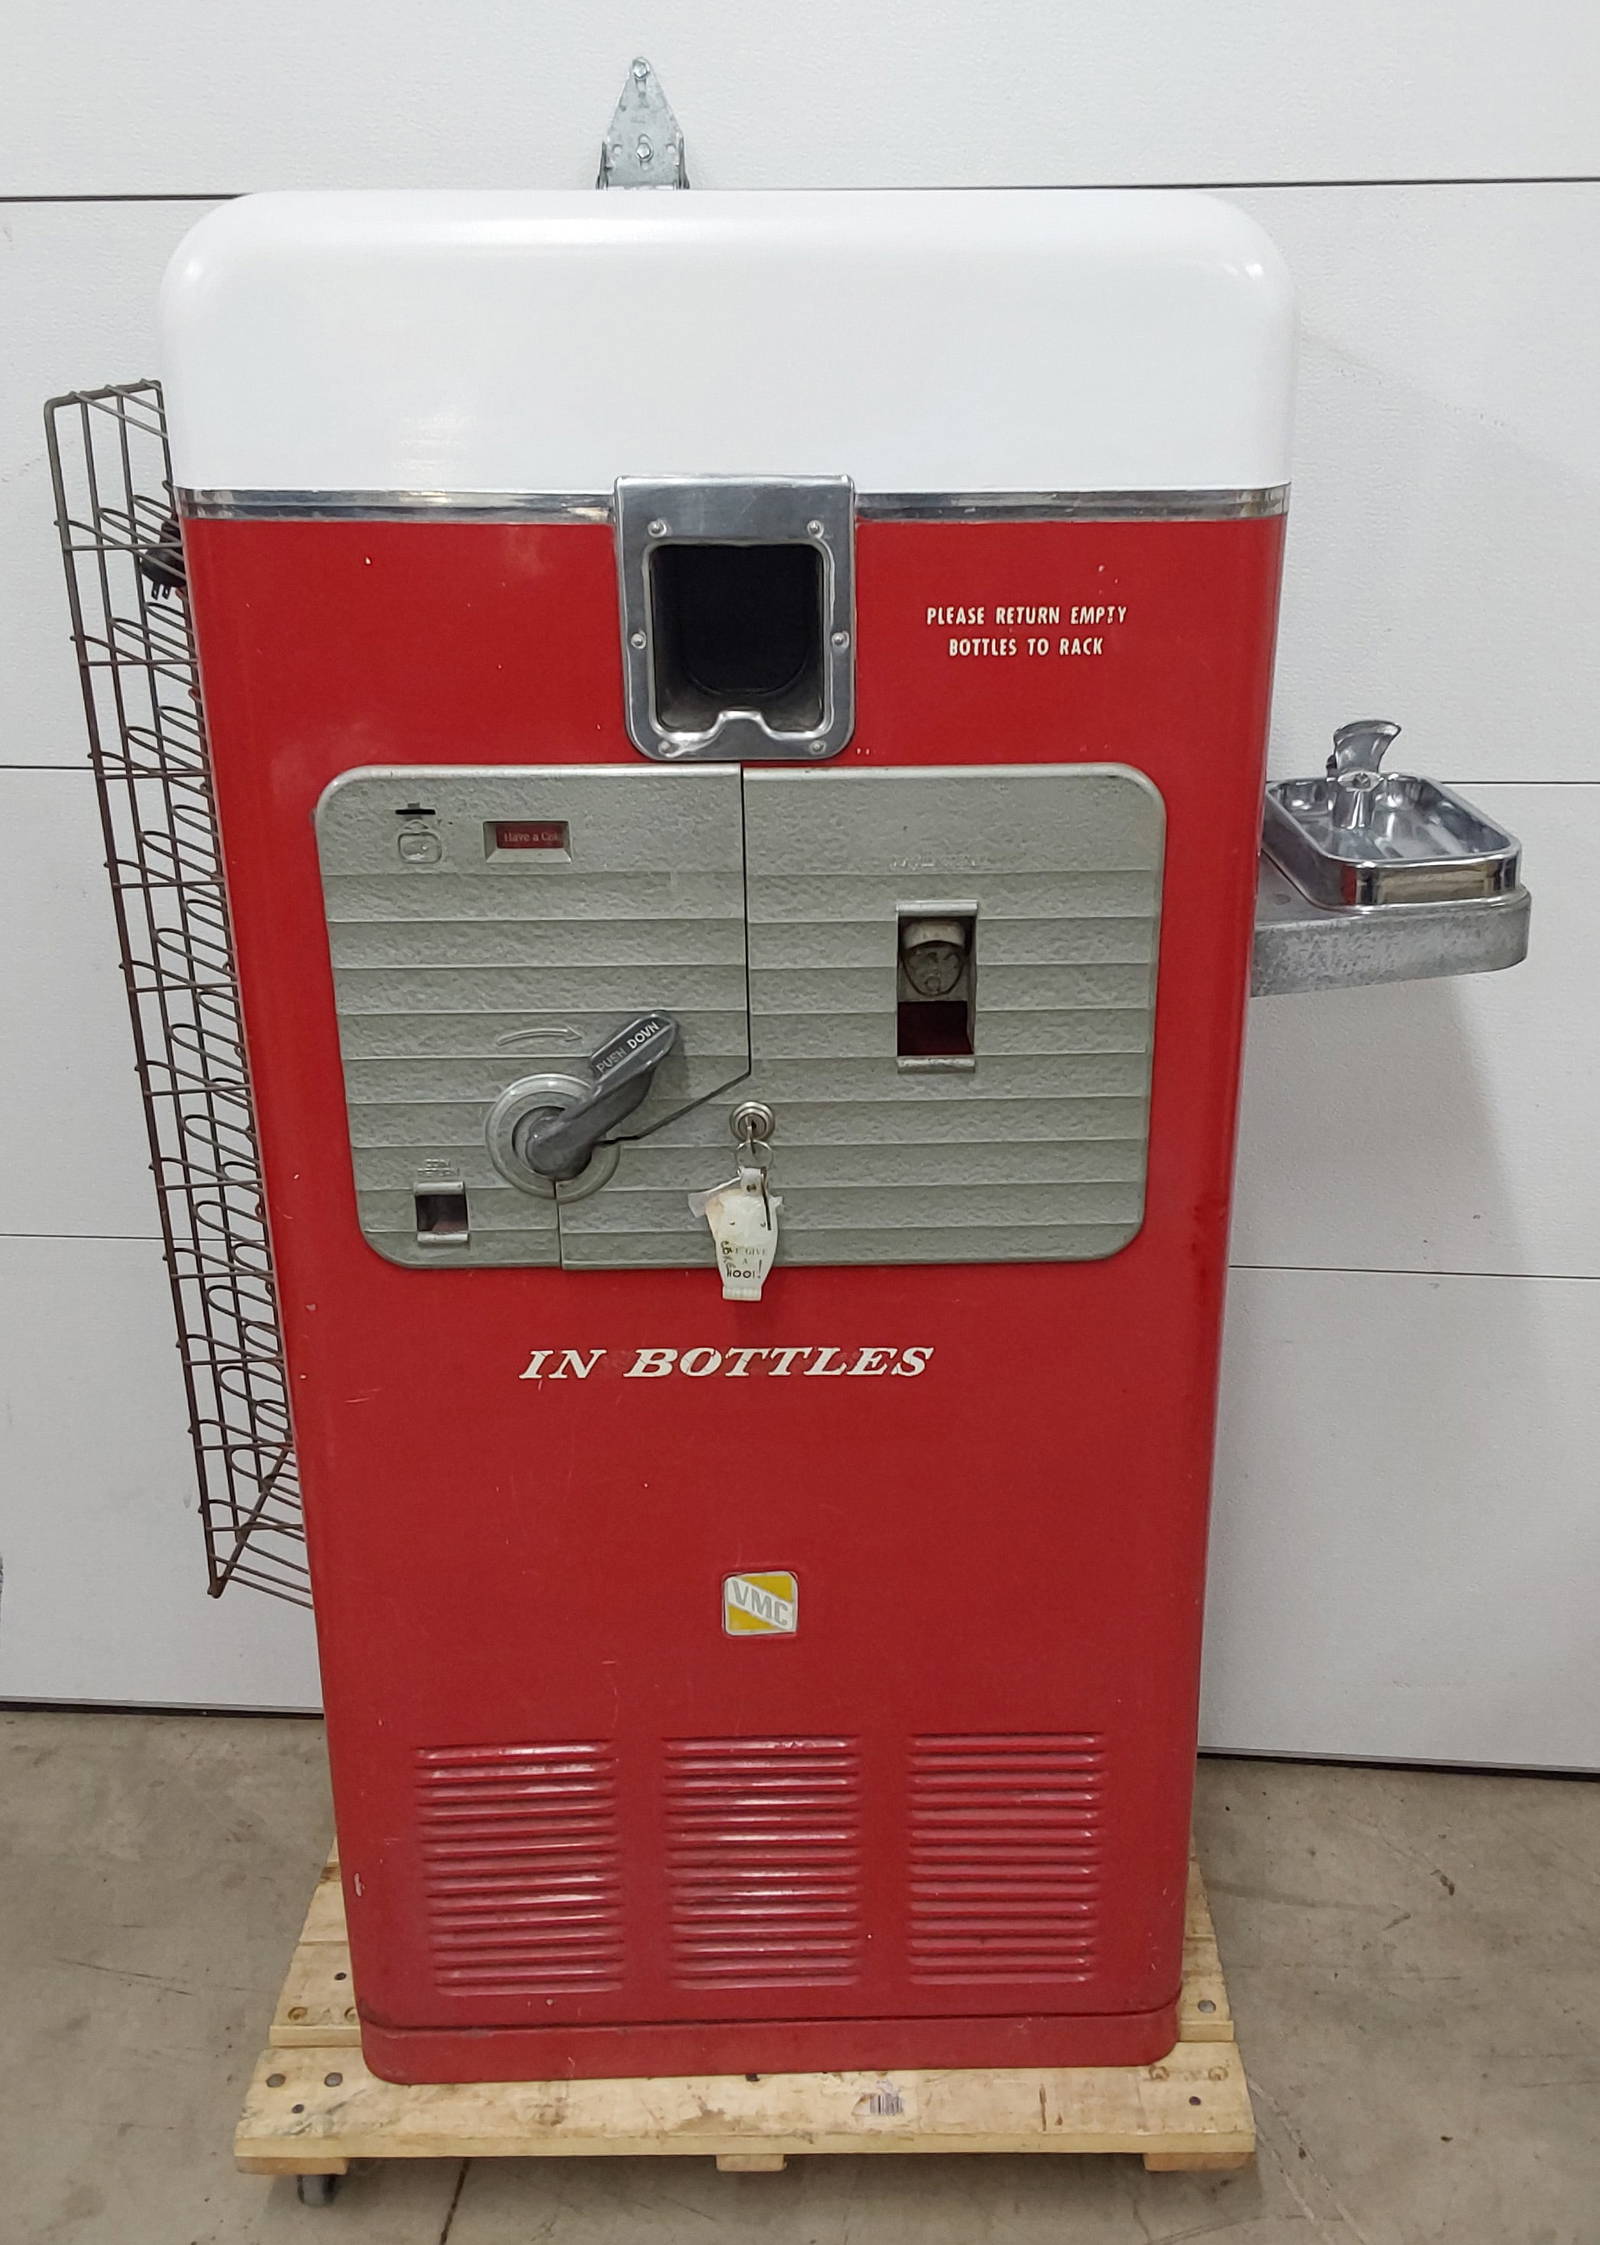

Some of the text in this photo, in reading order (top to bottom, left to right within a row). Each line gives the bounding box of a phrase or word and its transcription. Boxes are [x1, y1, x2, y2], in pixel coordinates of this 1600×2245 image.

[927, 606, 1127, 625] PLEASE RETURN EMPTY
[949, 637, 1104, 657] BOTTLES TO RACK
[504, 831, 530, 843] Have
[595, 1047, 628, 1073] PUSH
[518, 1346, 935, 1380] IN BOTTLES
[731, 1579, 790, 1627] VMC
